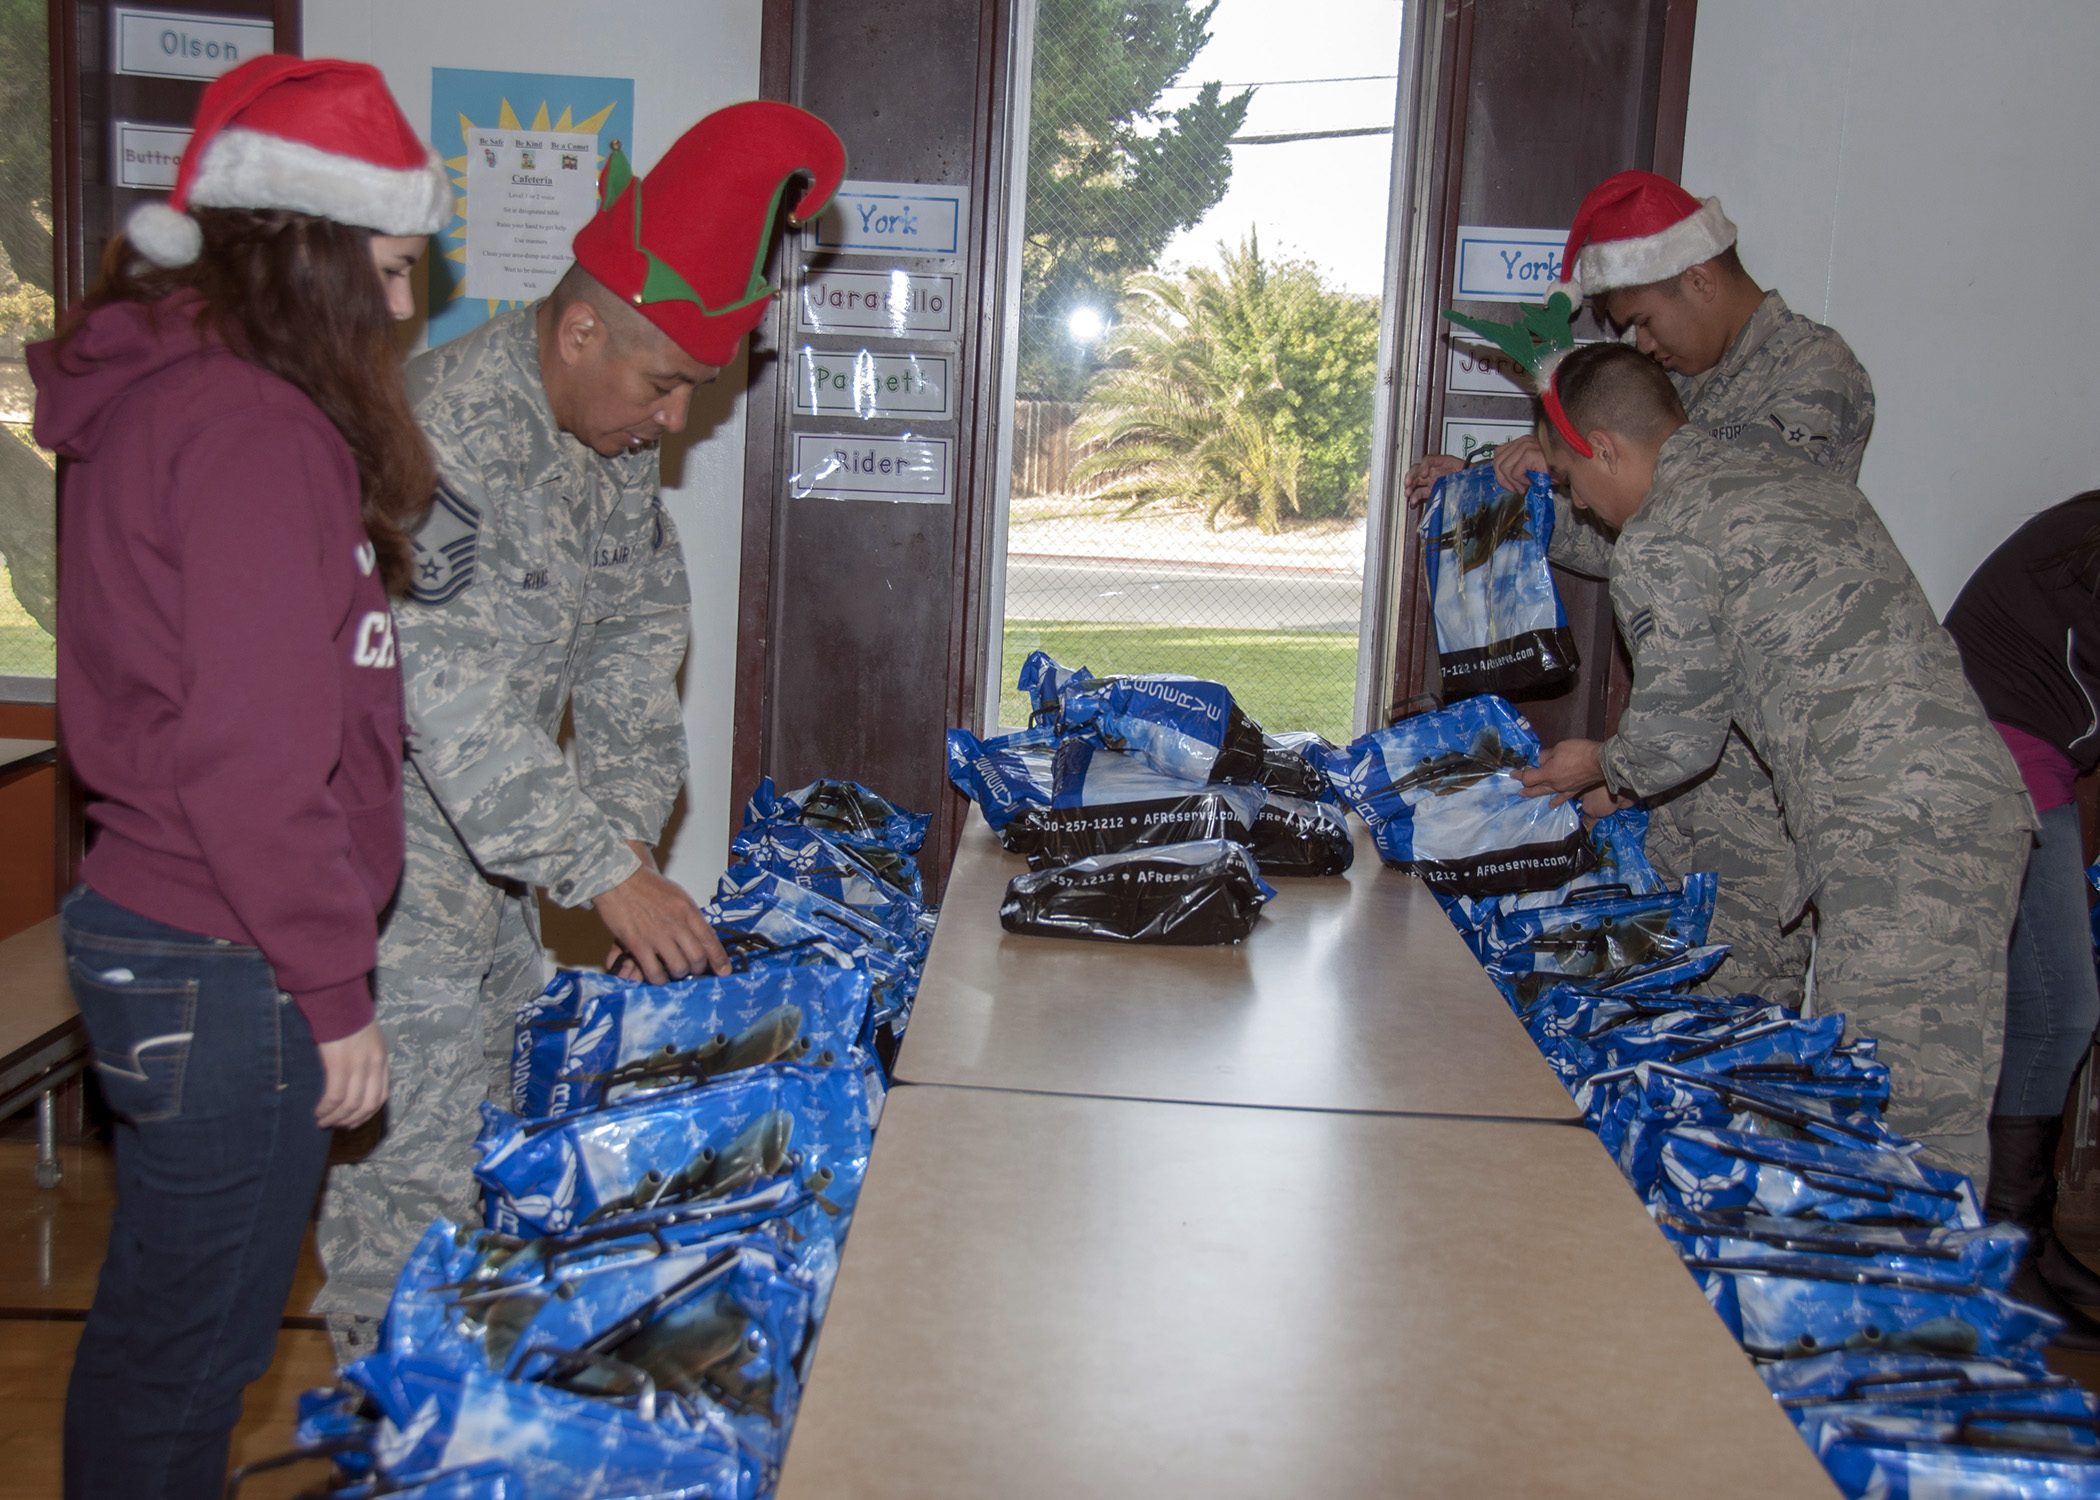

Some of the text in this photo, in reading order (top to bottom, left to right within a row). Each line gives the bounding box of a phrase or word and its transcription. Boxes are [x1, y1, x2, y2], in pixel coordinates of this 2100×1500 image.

[162, 31, 238, 60] Olson
[480, 138, 504, 147] Be Safe
[526, 140, 543, 148] Kind
[512, 174, 553, 186] Cafeteria
[857, 204, 918, 235] York
[1500, 250, 1562, 280] York
[813, 285, 943, 312] Jarallo
[816, 367, 928, 398] Paett
[836, 450, 910, 475] Rider
[1476, 854, 1567, 878] AFReserve.com
